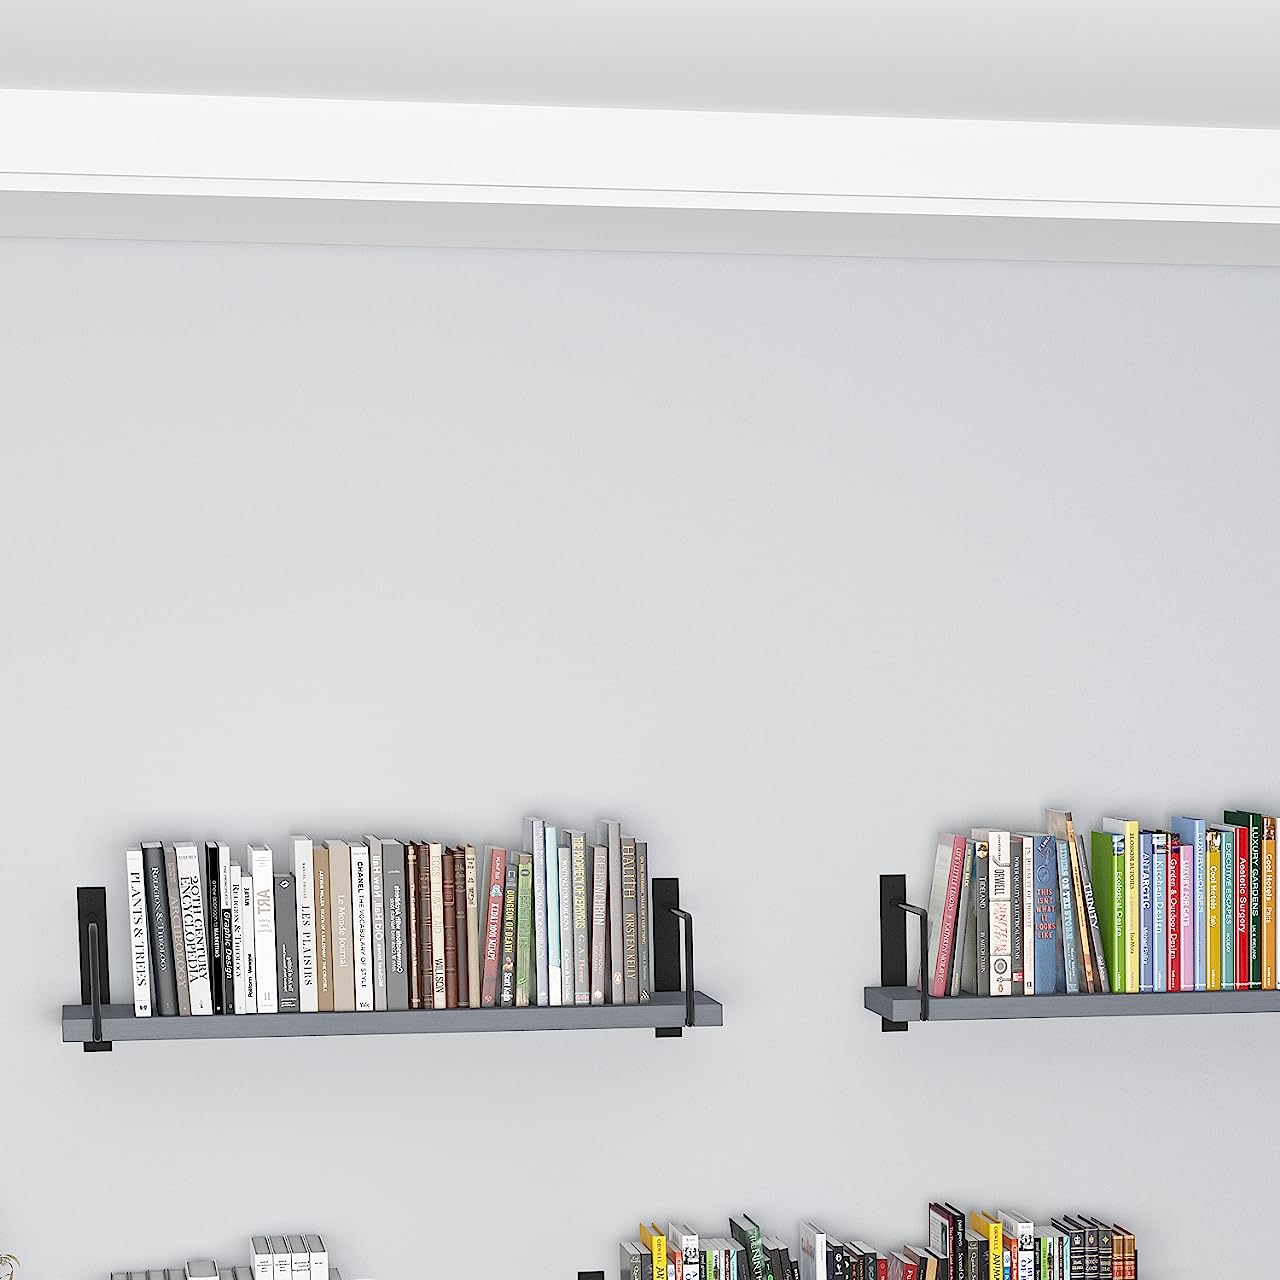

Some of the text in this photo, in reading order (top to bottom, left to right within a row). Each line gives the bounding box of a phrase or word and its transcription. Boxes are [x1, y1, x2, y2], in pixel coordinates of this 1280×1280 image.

[1142, 852, 1150, 909] ANTARCTIC
[1155, 860, 1164, 934] Kitchen Design
[1182, 860, 1190, 889] LUXURY
[506, 890, 514, 920] DUNGEON
[1084, 882, 1099, 929] TRINITY
[134, 928, 144, 938] &
[180, 876, 198, 983] ENCYCLOPEDIA
[193, 918, 208, 980] CENTURY
[223, 911, 233, 979] Graphic Design
[504, 932, 513, 953] DEATH
[625, 913, 636, 980] KIRSTEN KELLY
[135, 942, 146, 986] TREES
[868, 1256, 874, 1264] A
[1021, 1260, 1027, 1273] OF
